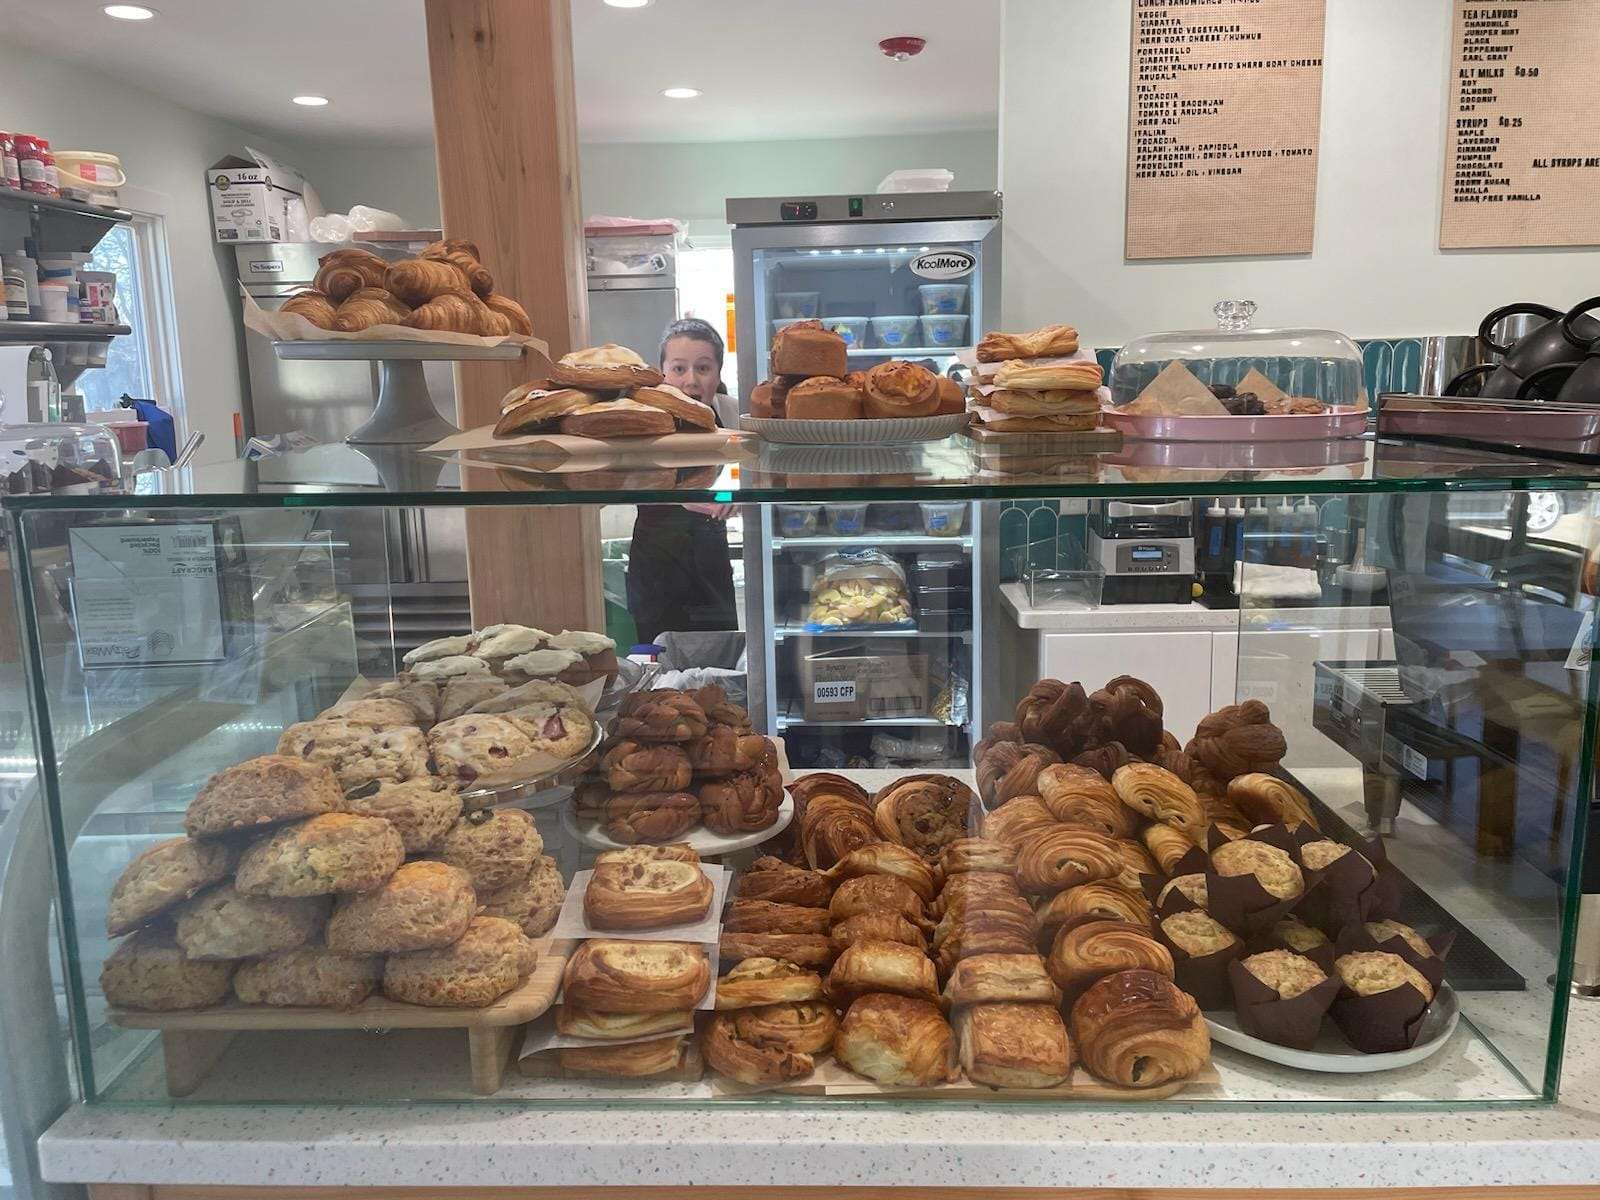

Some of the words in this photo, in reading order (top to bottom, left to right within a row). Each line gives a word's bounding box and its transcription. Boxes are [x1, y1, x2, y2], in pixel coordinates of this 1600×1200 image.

[1463, 10, 1478, 19] TEA
[1481, 9, 1518, 19] FLAVORS
[1141, 19, 1181, 27] CIABATTA
[1141, 27, 1183, 35] ASSORTED
[1186, 25, 1240, 34] VEGETABLES
[1188, 34, 1220, 42] CHEESE
[1137, 47, 1191, 55] PORTABELLO
[1140, 56, 1180, 64] CIABATTA
[1206, 62, 1233, 70] PESTO
[1266, 60, 1287, 68] GOAT
[1290, 59, 1322, 67] CHEESE
[1459, 69, 1474, 78] ALT
[1478, 68, 1504, 78] MILKS
[1515, 66, 1539, 77] $0.50
[1138, 101, 1169, 109] TURKEY
[1456, 118, 1488, 128] SYRUPS
[1499, 116, 1522, 127] $0.25
[1532, 159, 1548, 168] ALL
[1585, 158, 1600, 167] ARE
[917, 258, 967, 270] KoolMore
[816, 687, 838, 698] 00593
[840, 686, 854, 696] CFP
